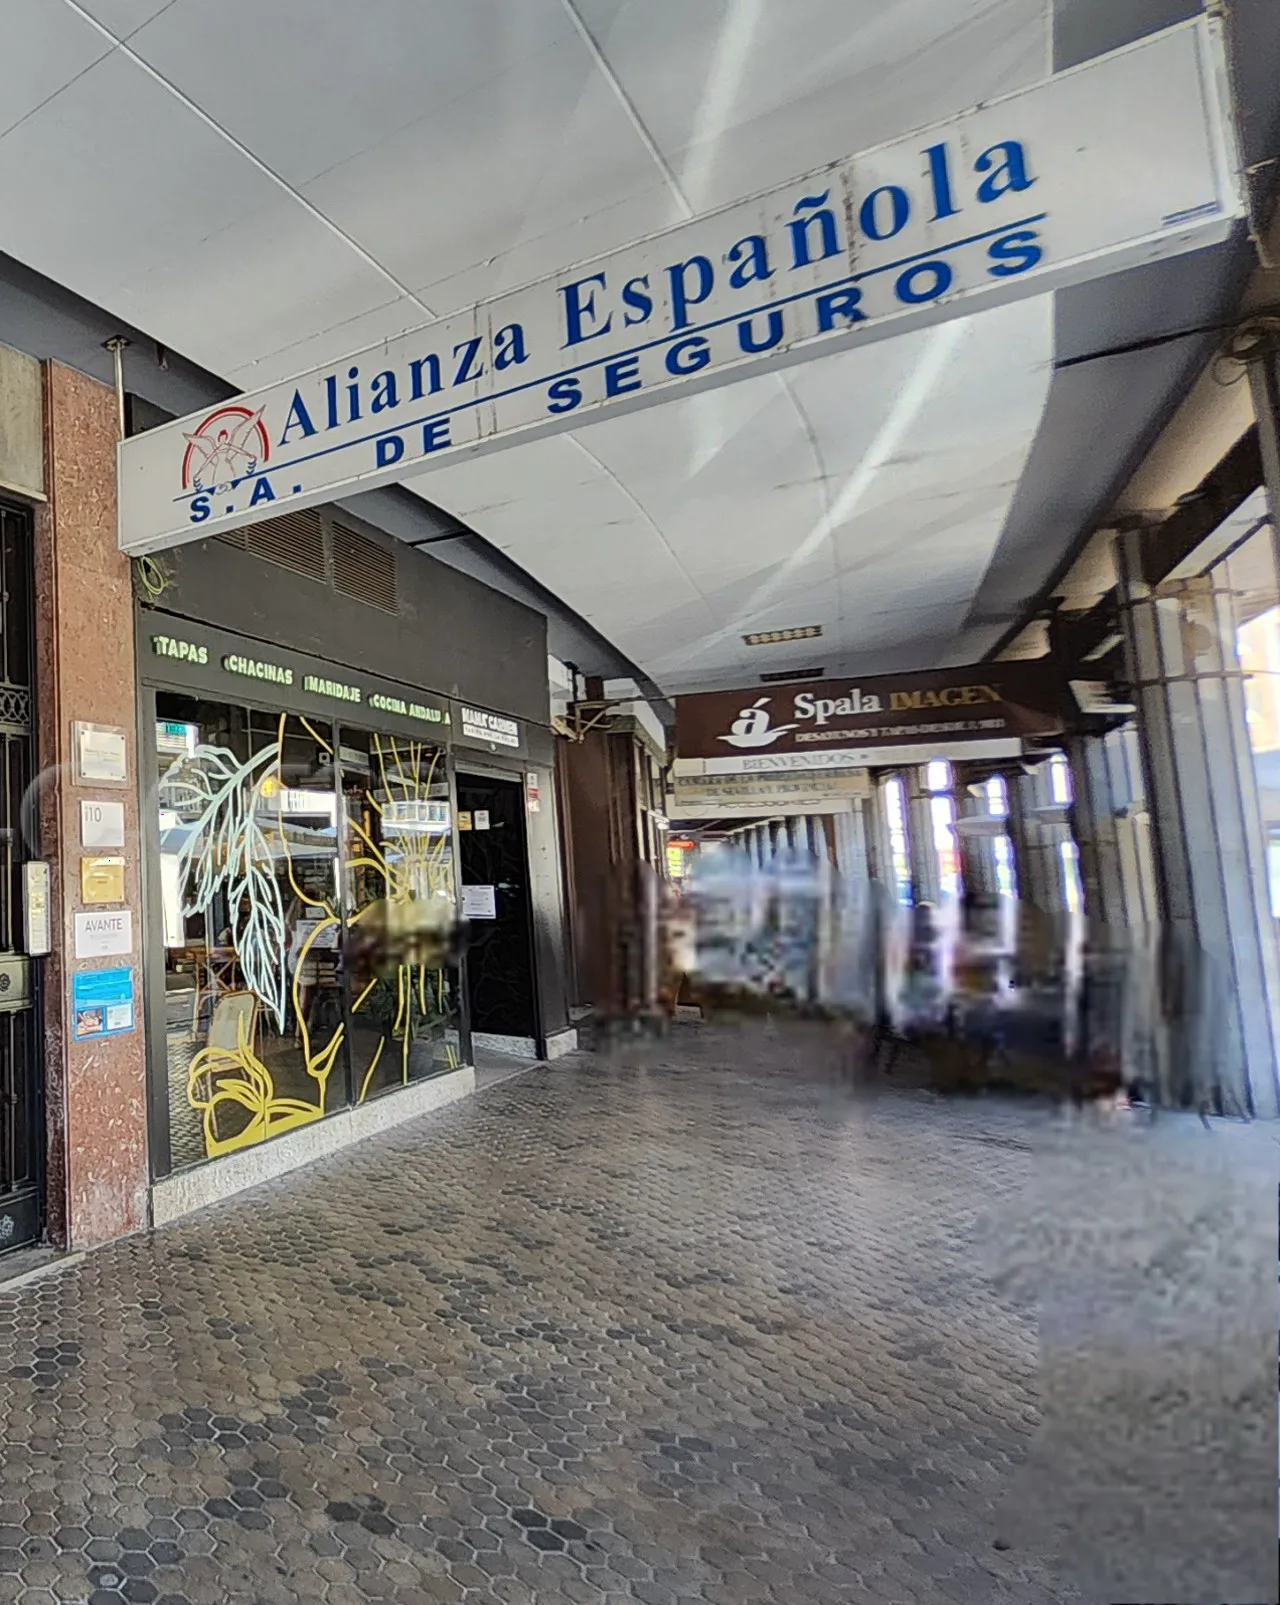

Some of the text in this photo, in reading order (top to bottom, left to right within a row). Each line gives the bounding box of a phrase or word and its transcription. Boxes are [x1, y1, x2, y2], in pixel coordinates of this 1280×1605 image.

[276, 138, 1037, 447] Alianza Española
[188, 229, 1046, 524] S.A. DE SEGUROS
[154, 635, 209, 664] TAPAS
[224, 654, 293, 685] CHACINAS
[304, 675, 361, 702] MARIDAJE
[370, 693, 407, 715] COCINA
[794, 689, 883, 726] Spala
[84, 806, 102, 823] i10
[84, 918, 123, 932] AVANTE
